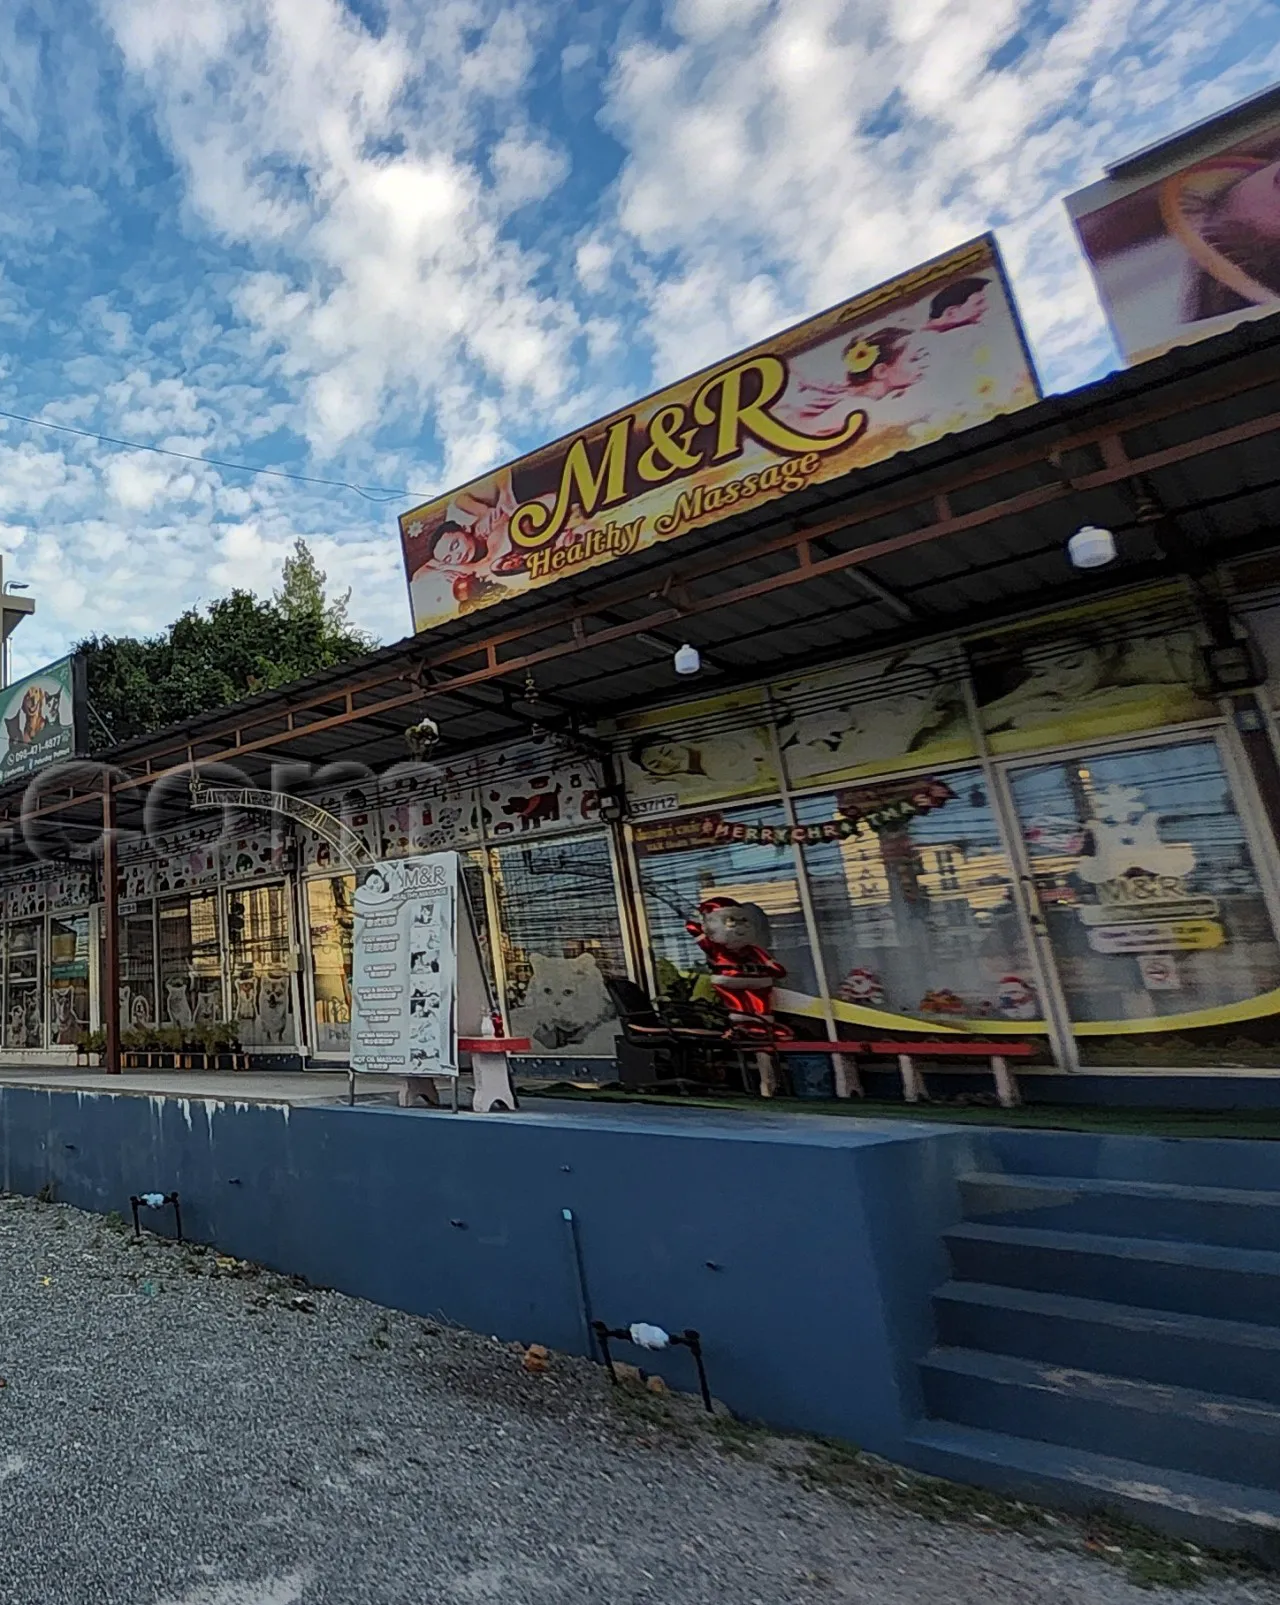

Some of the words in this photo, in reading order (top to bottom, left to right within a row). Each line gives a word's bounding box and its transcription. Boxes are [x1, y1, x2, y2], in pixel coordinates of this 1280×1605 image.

[510, 355, 867, 548] M&R
[525, 517, 645, 580] Healthy
[654, 450, 822, 535] Massage
[404, 865, 447, 889] M&R
[1102, 875, 1185, 901] M&R
[418, 887, 447, 898] MASSAGE
